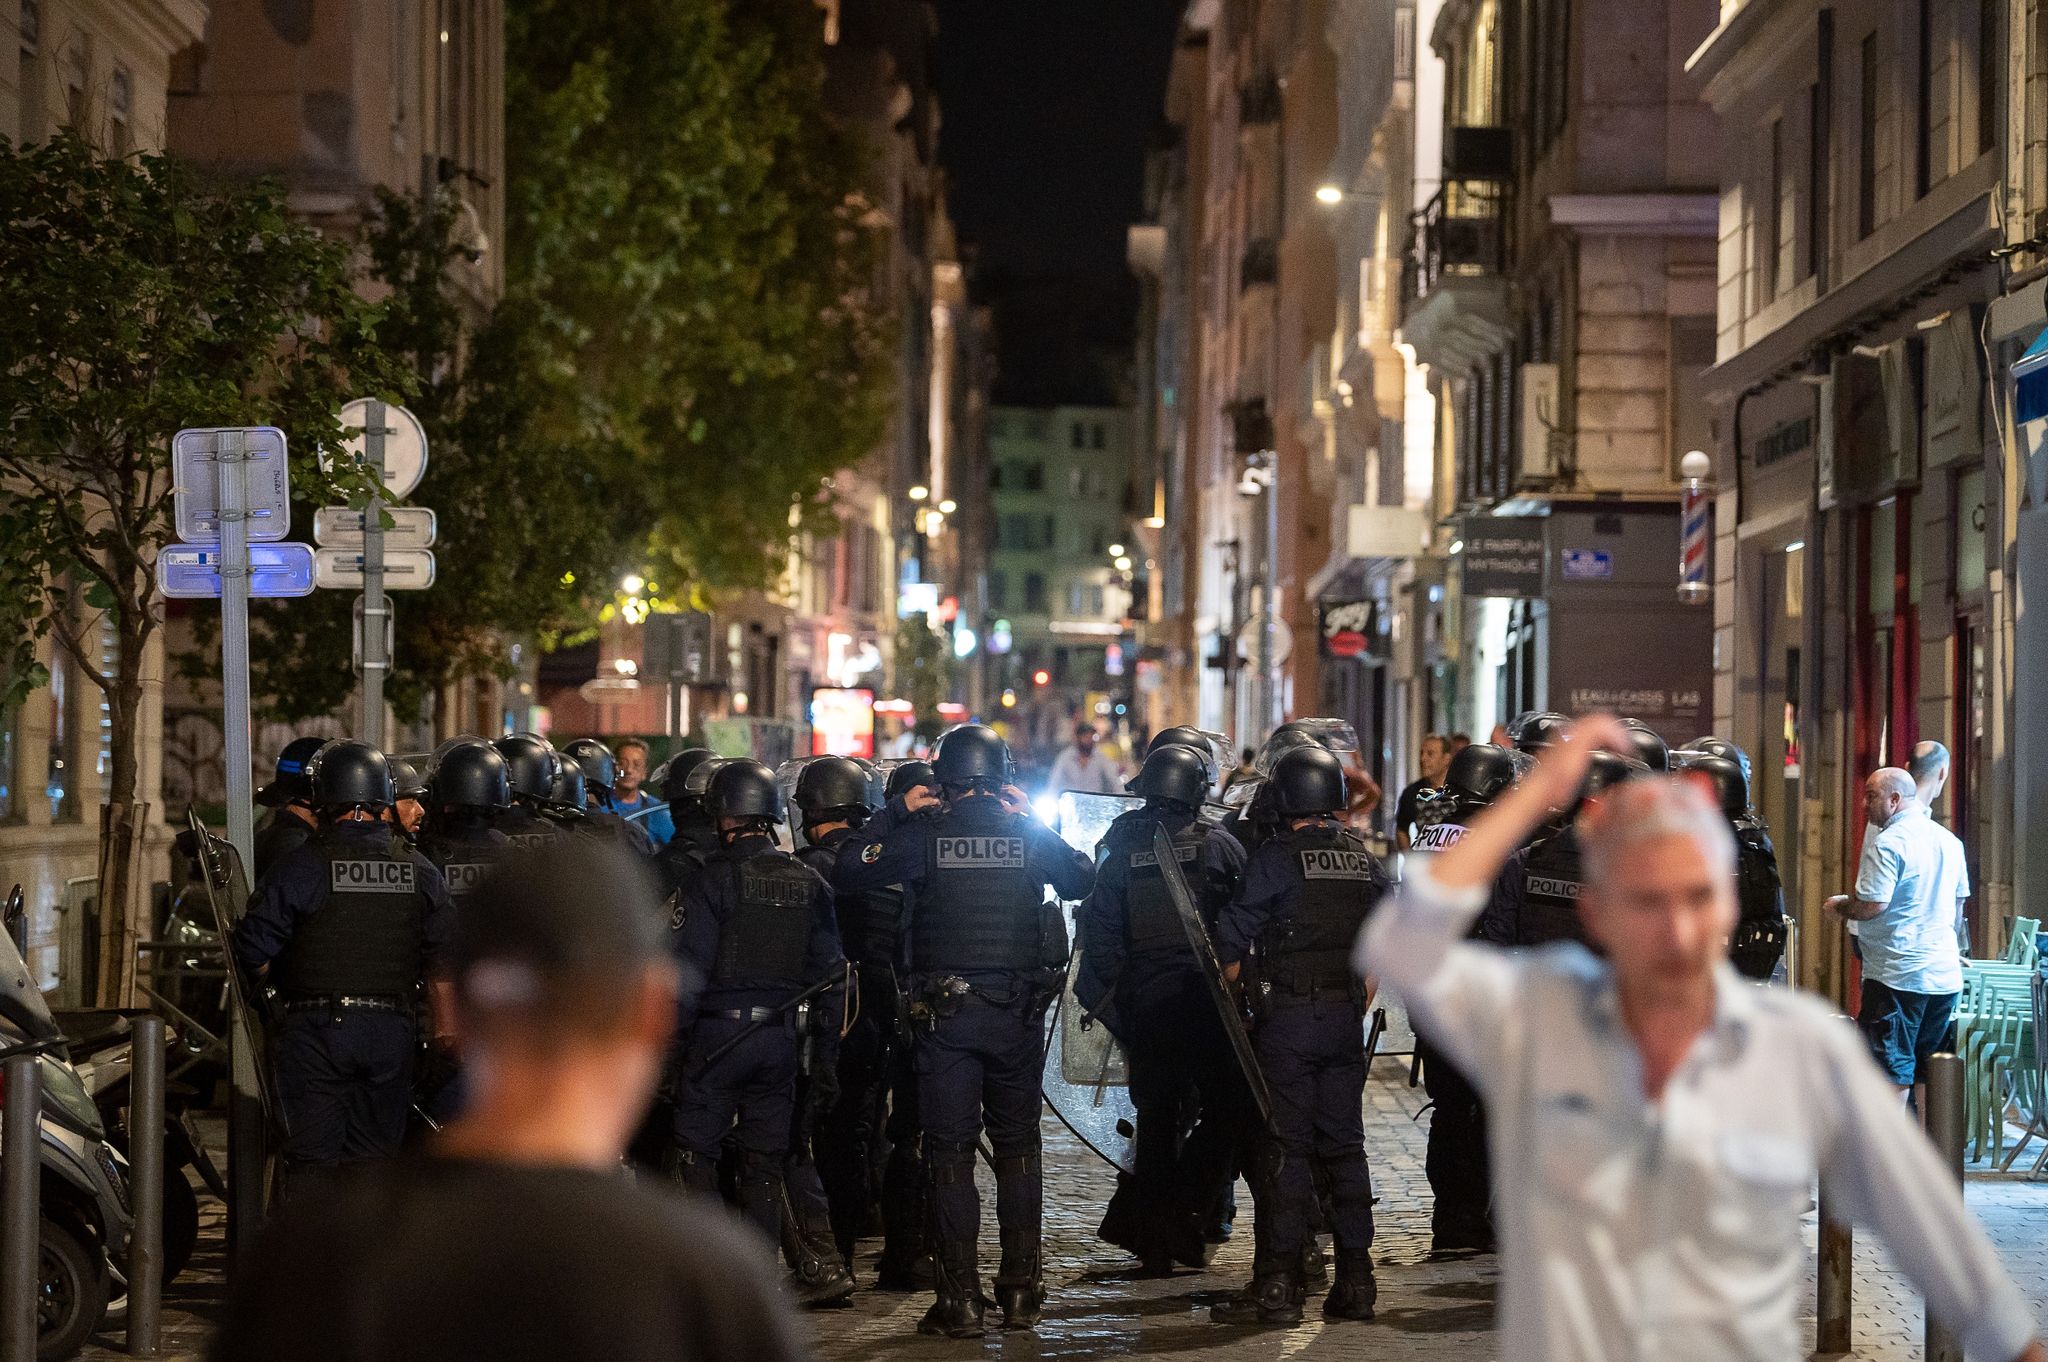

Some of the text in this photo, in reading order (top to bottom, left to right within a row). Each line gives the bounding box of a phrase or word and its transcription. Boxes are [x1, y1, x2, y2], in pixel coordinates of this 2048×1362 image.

[939, 839, 1022, 859] POLICE
[1303, 852, 1369, 872] POLICE
[335, 863, 412, 884] POLICE
[744, 877, 809, 905] POLICE
